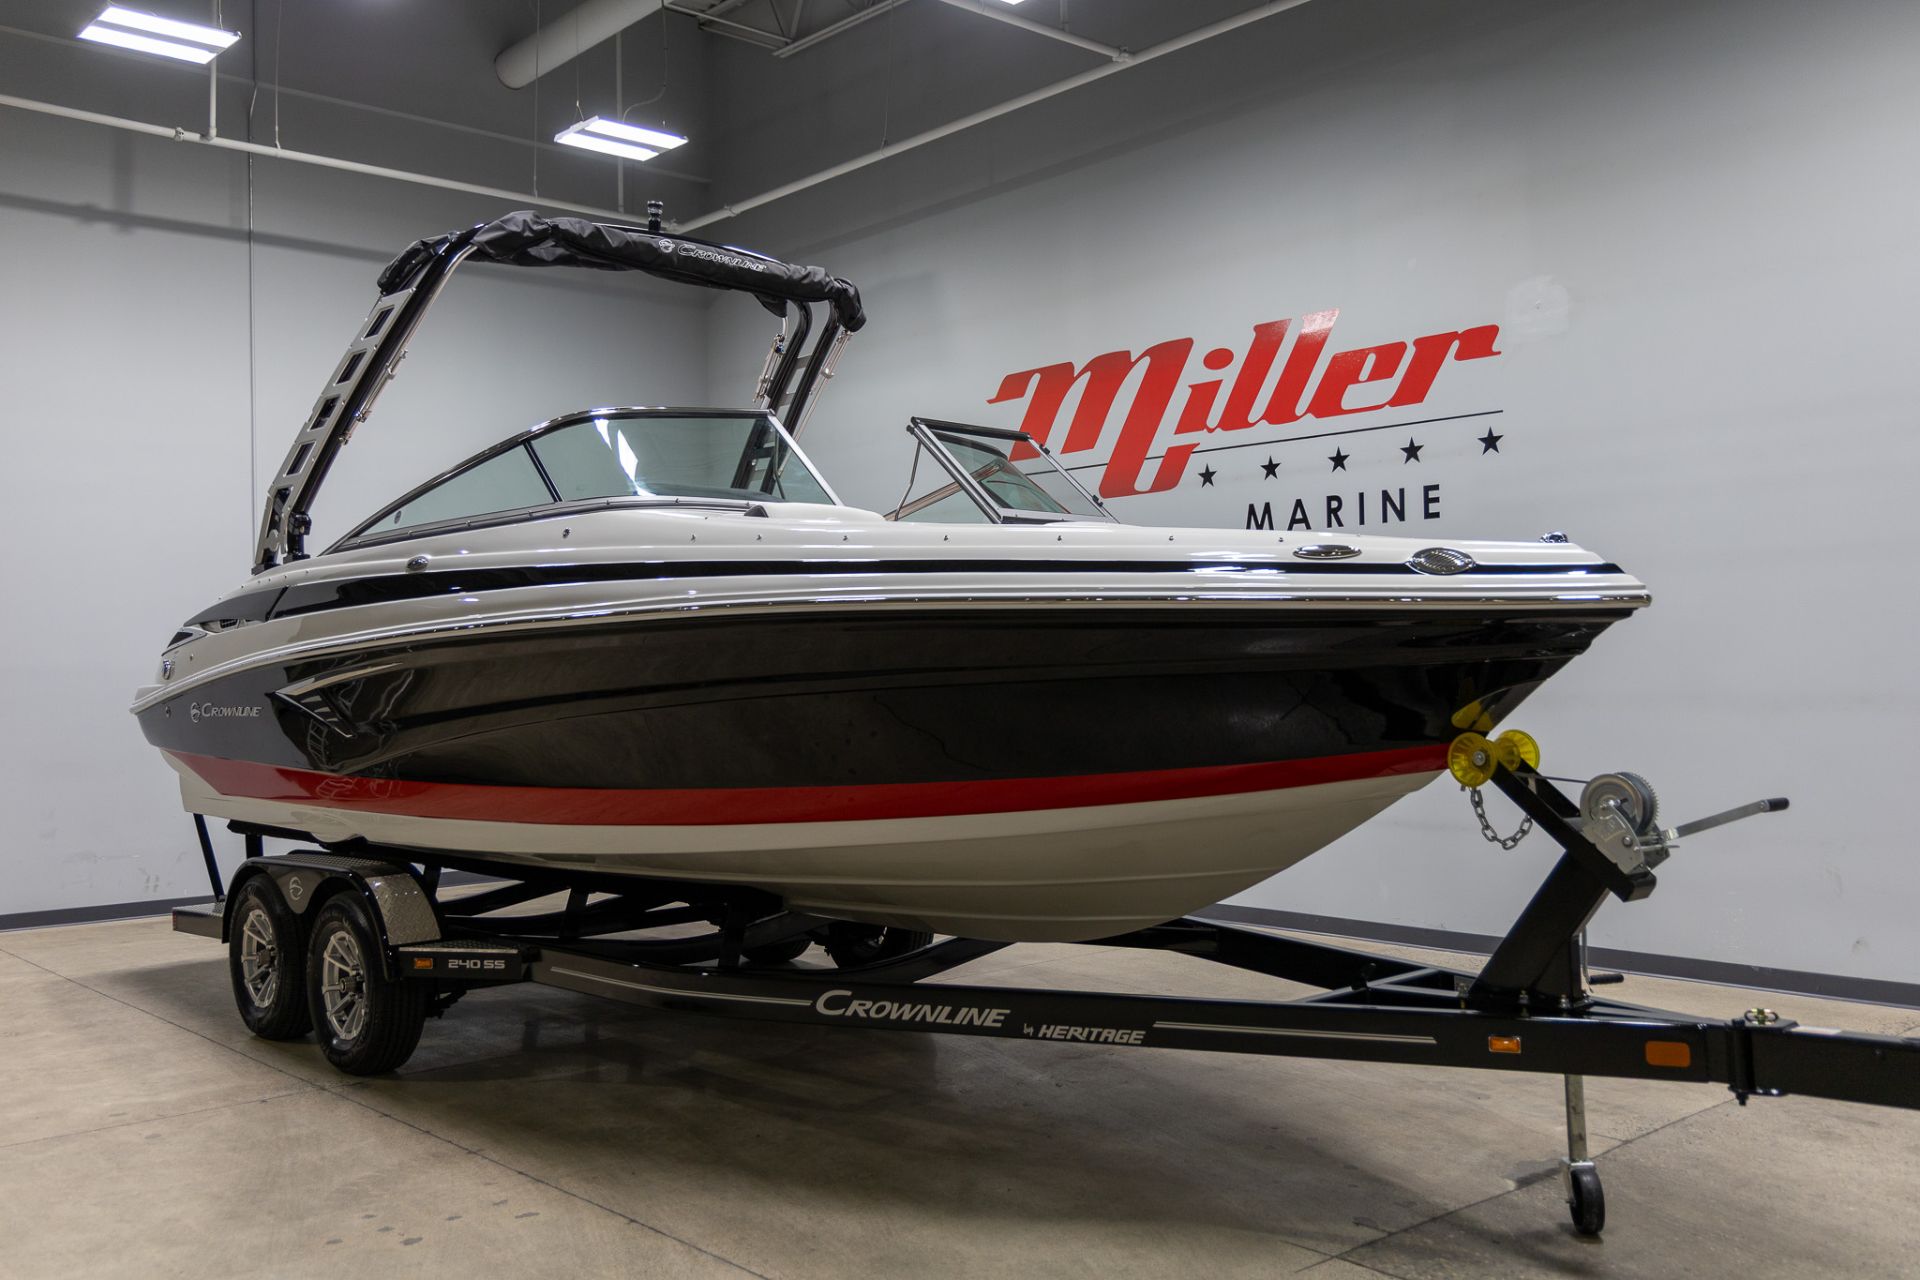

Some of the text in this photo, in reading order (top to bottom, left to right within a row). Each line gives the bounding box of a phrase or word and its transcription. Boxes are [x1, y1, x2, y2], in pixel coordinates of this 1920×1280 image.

[678, 243, 767, 272] CROWNLINE
[986, 308, 1501, 498] Miller
[1246, 484, 1440, 530] MARINE
[201, 703, 262, 717] CROWNLINE
[448, 960, 505, 969] 240 SS
[815, 989, 1010, 1027] CROWNLINE
[1038, 1023, 1146, 1045] HERITAGE
